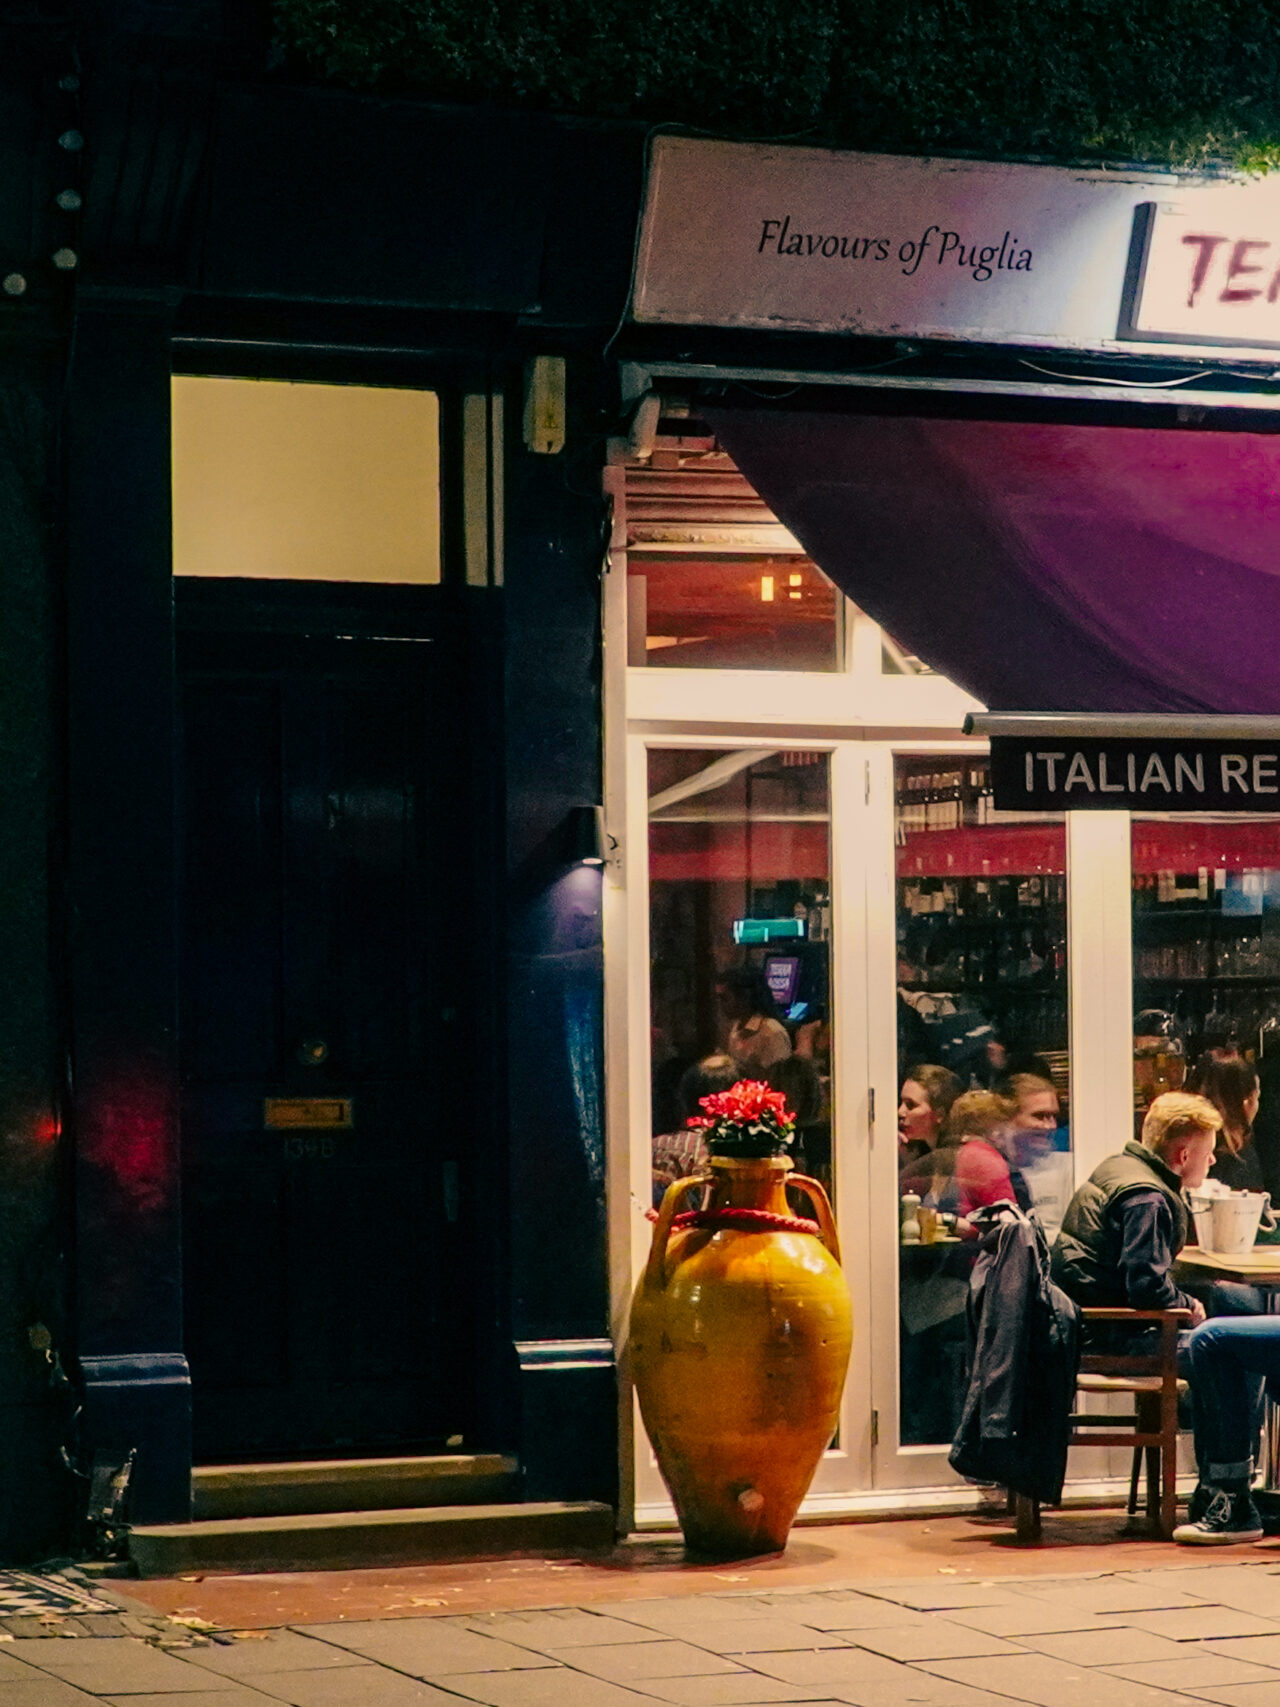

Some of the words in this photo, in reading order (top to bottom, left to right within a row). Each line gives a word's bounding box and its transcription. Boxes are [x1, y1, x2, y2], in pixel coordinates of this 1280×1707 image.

[758, 215, 891, 262] Flavours
[898, 225, 940, 276] of
[938, 231, 1033, 282] Puglia
[1025, 751, 1206, 793] ITALIAN
